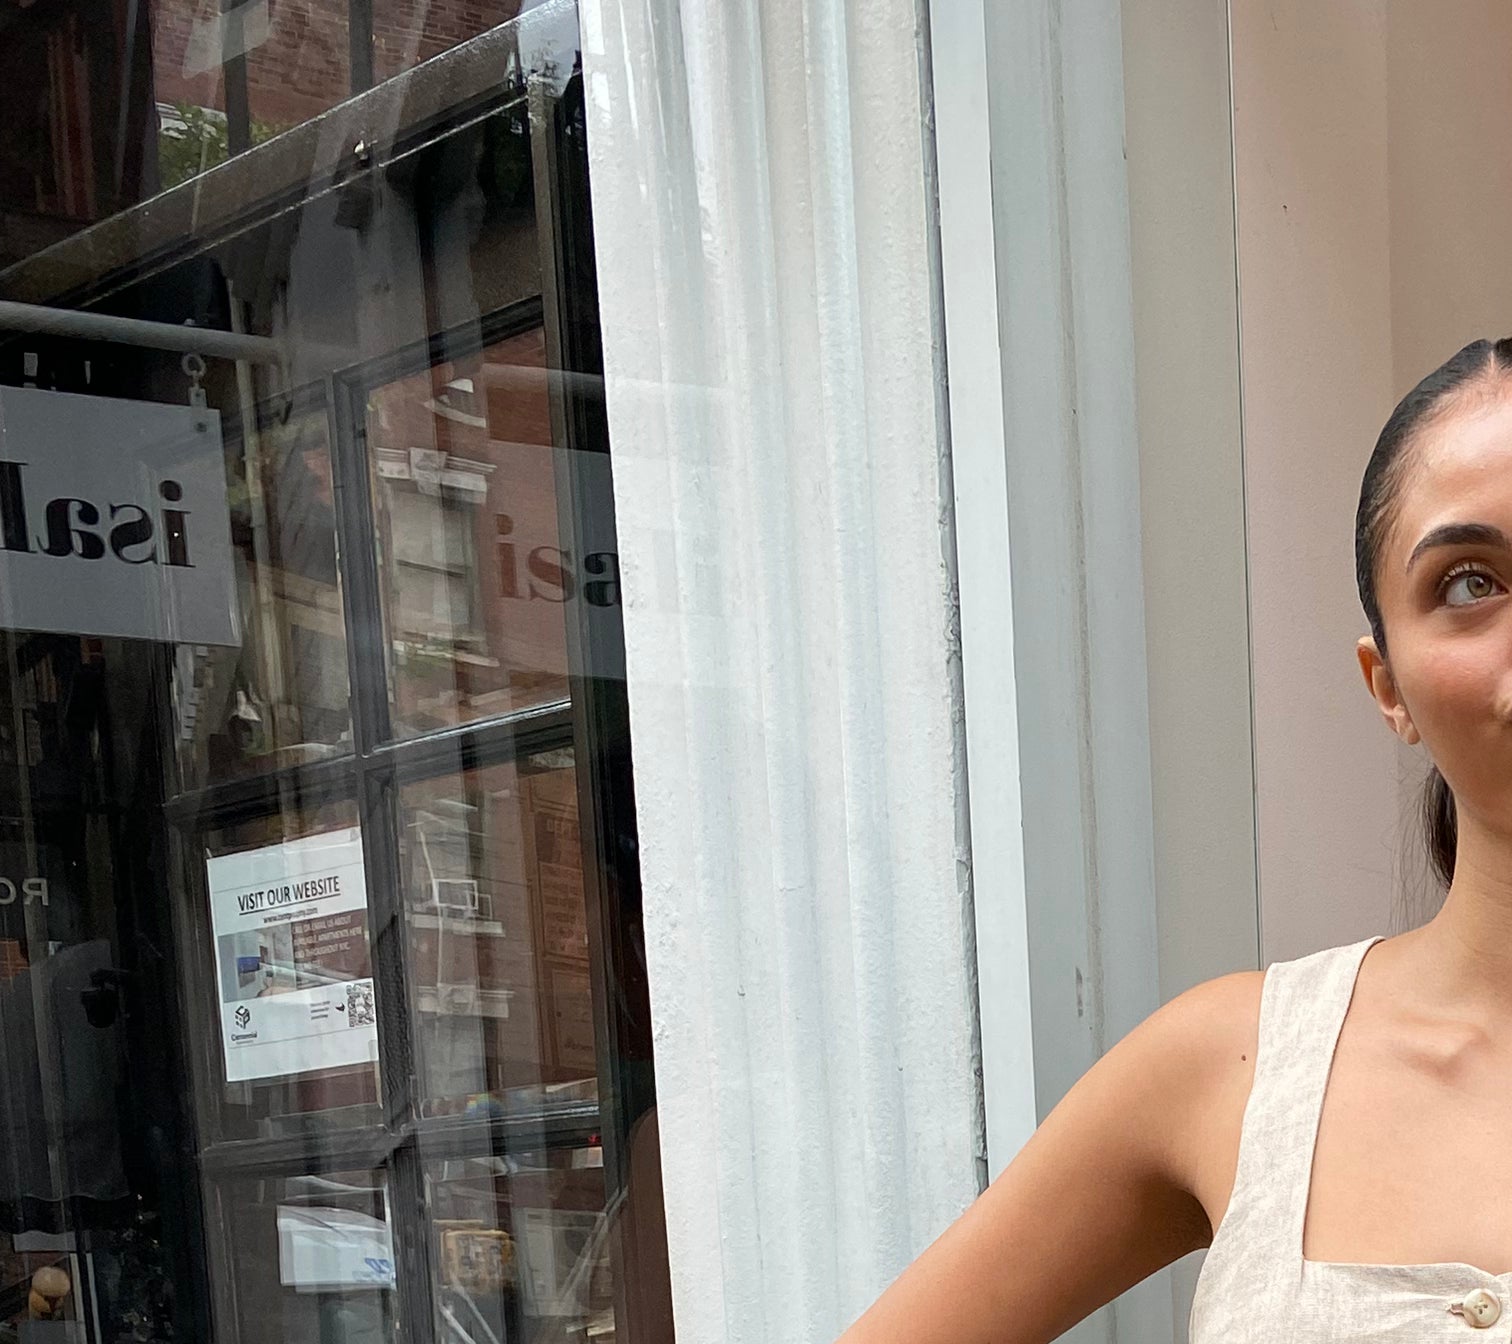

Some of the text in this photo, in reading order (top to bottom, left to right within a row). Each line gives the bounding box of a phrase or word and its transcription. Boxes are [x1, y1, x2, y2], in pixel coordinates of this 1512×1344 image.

[237, 875, 340, 912] VISIT OUR WEBSITE
